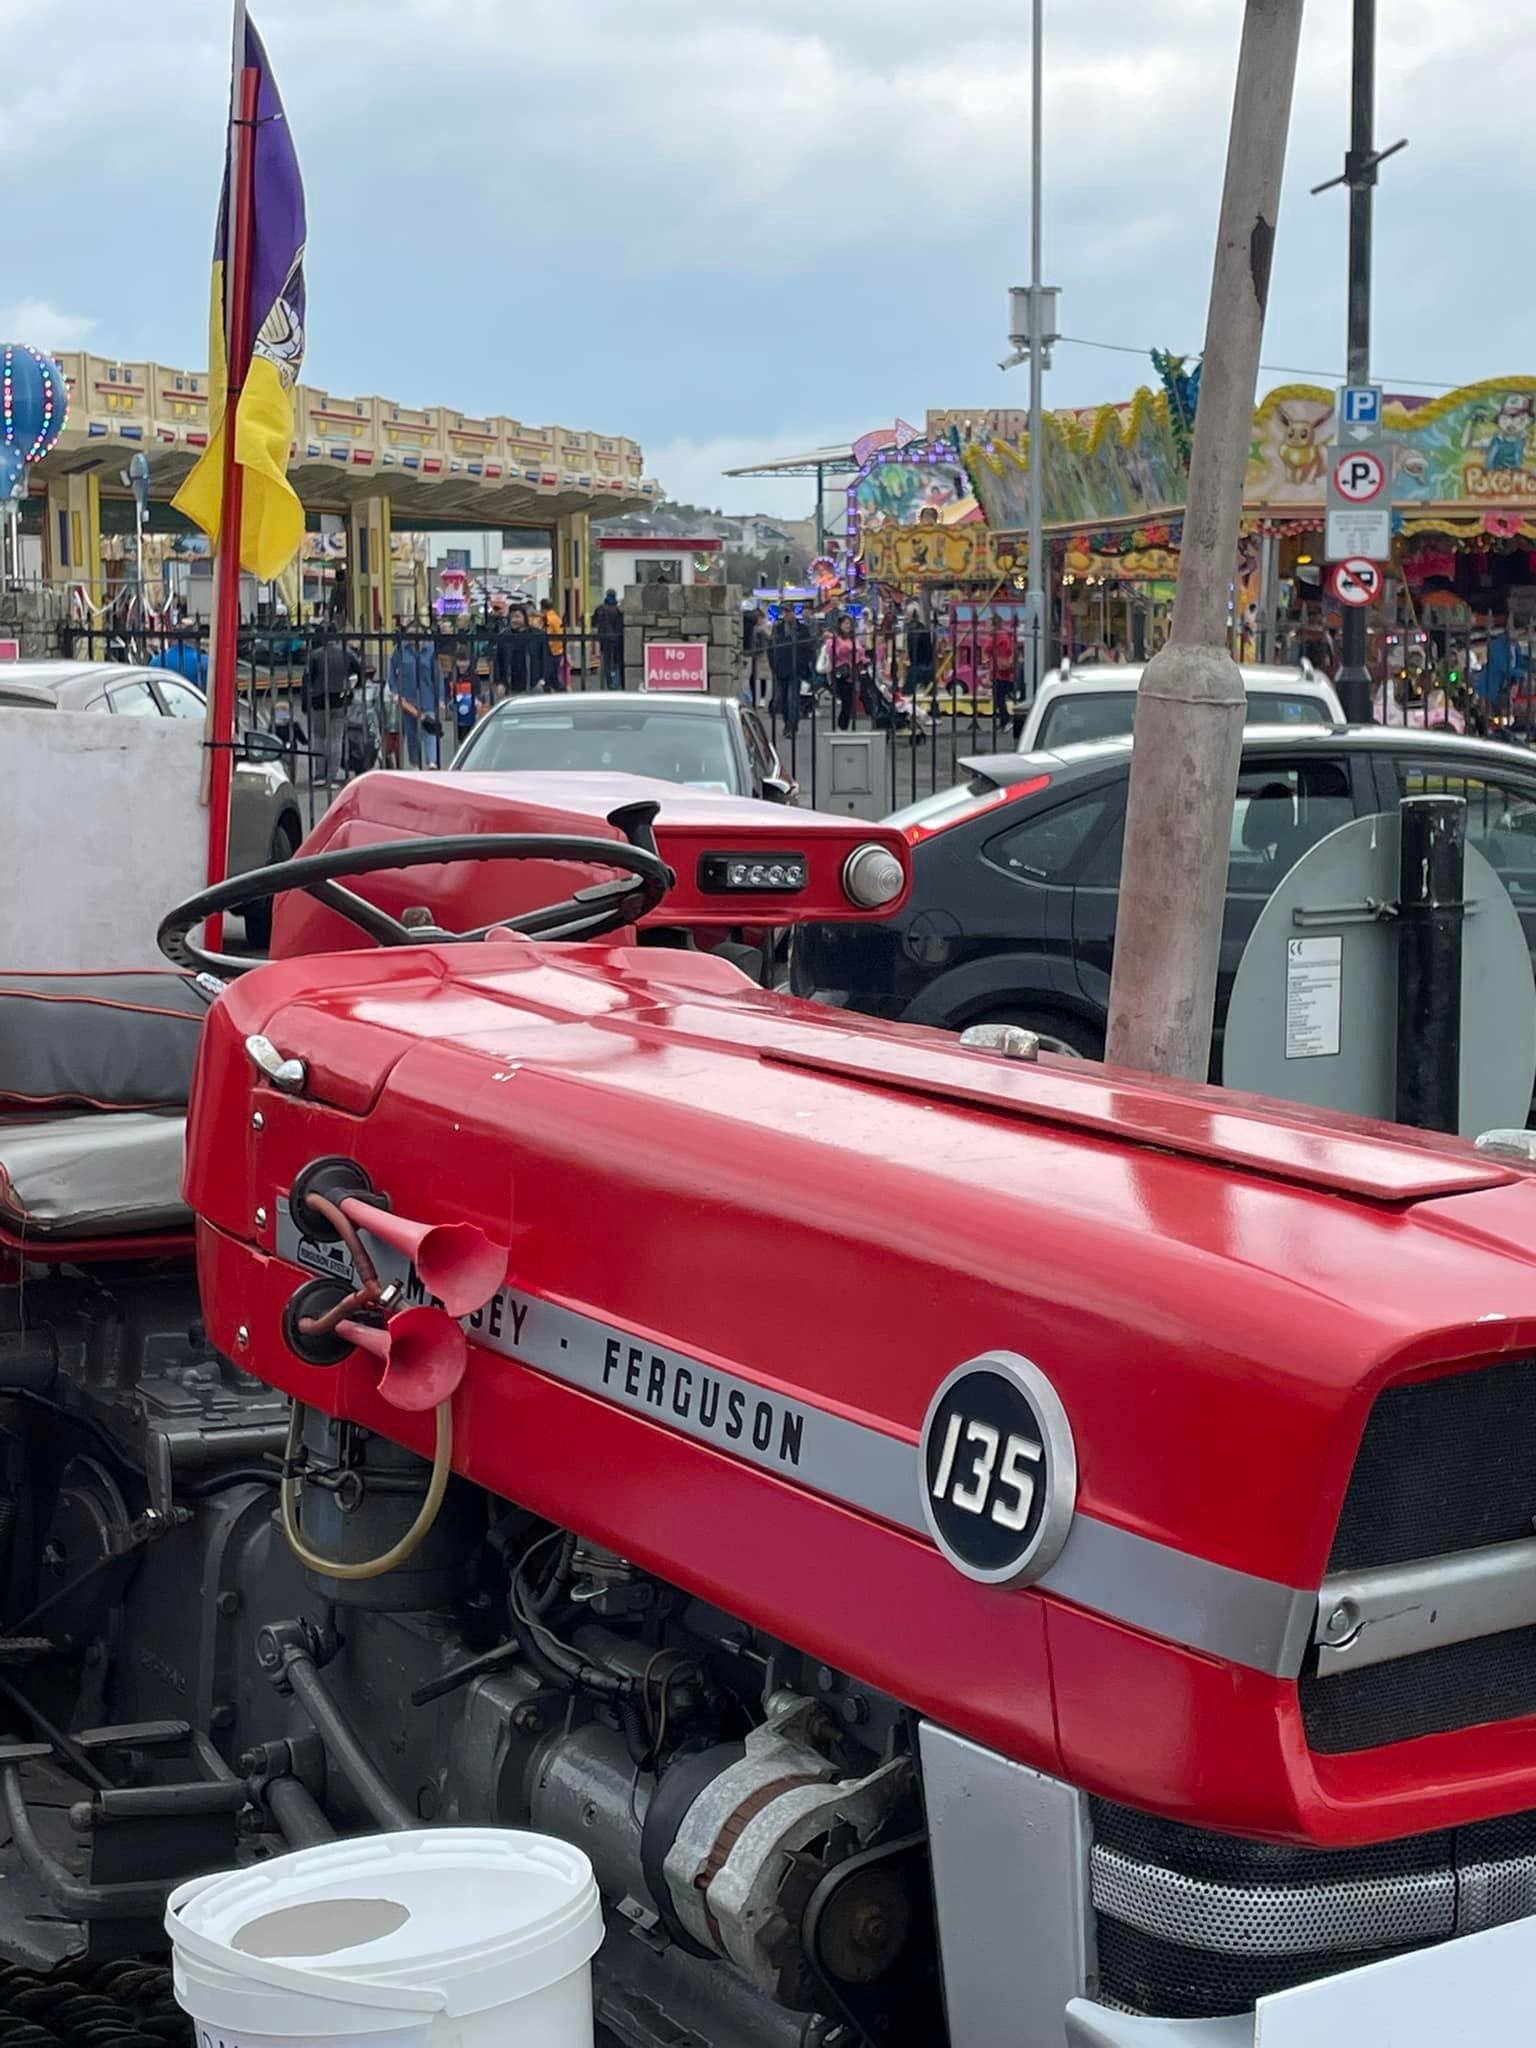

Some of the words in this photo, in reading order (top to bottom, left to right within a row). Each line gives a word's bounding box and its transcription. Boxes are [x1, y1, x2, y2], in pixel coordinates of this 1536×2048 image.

[1353, 391, 1375, 420] P
[1351, 462, 1370, 490] P
[665, 648, 685, 660] No
[649, 669, 704, 681] Alcohol
[602, 1337, 804, 1466] FERGUSON
[933, 1413, 1042, 1532] 135
